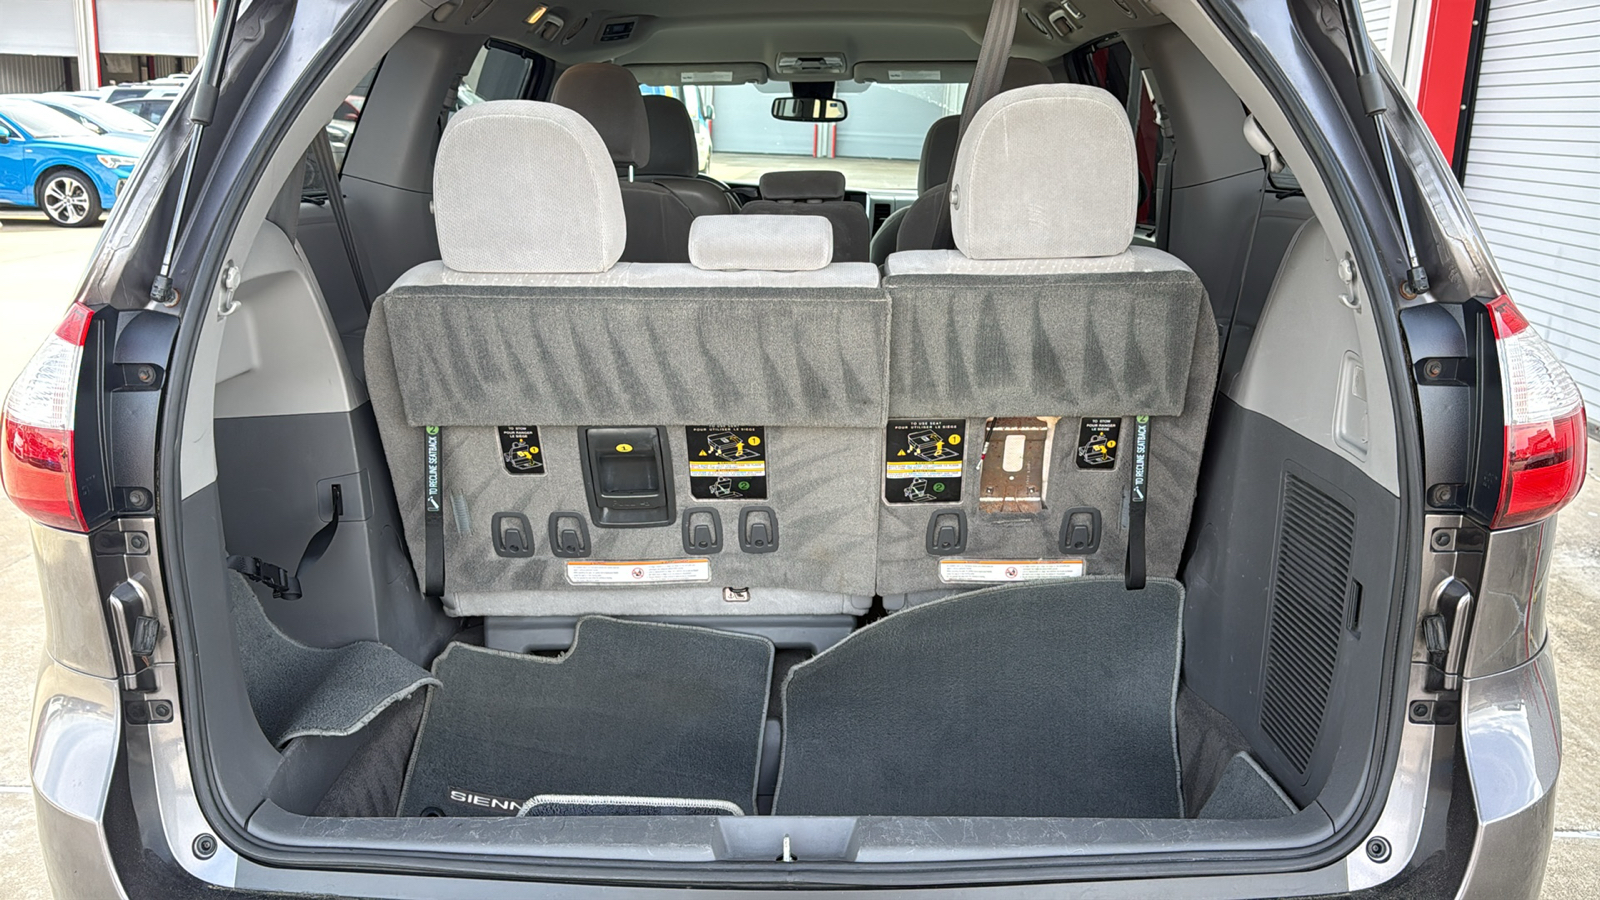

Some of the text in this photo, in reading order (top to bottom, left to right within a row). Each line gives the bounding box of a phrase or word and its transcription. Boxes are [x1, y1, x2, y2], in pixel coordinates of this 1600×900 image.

[428, 436, 438, 464] SEATBACK
[1135, 425, 1147, 485] TO RECLINE SEATBACK
[428, 465, 438, 487] RECLINE
[450, 790, 524, 811] SIENN
